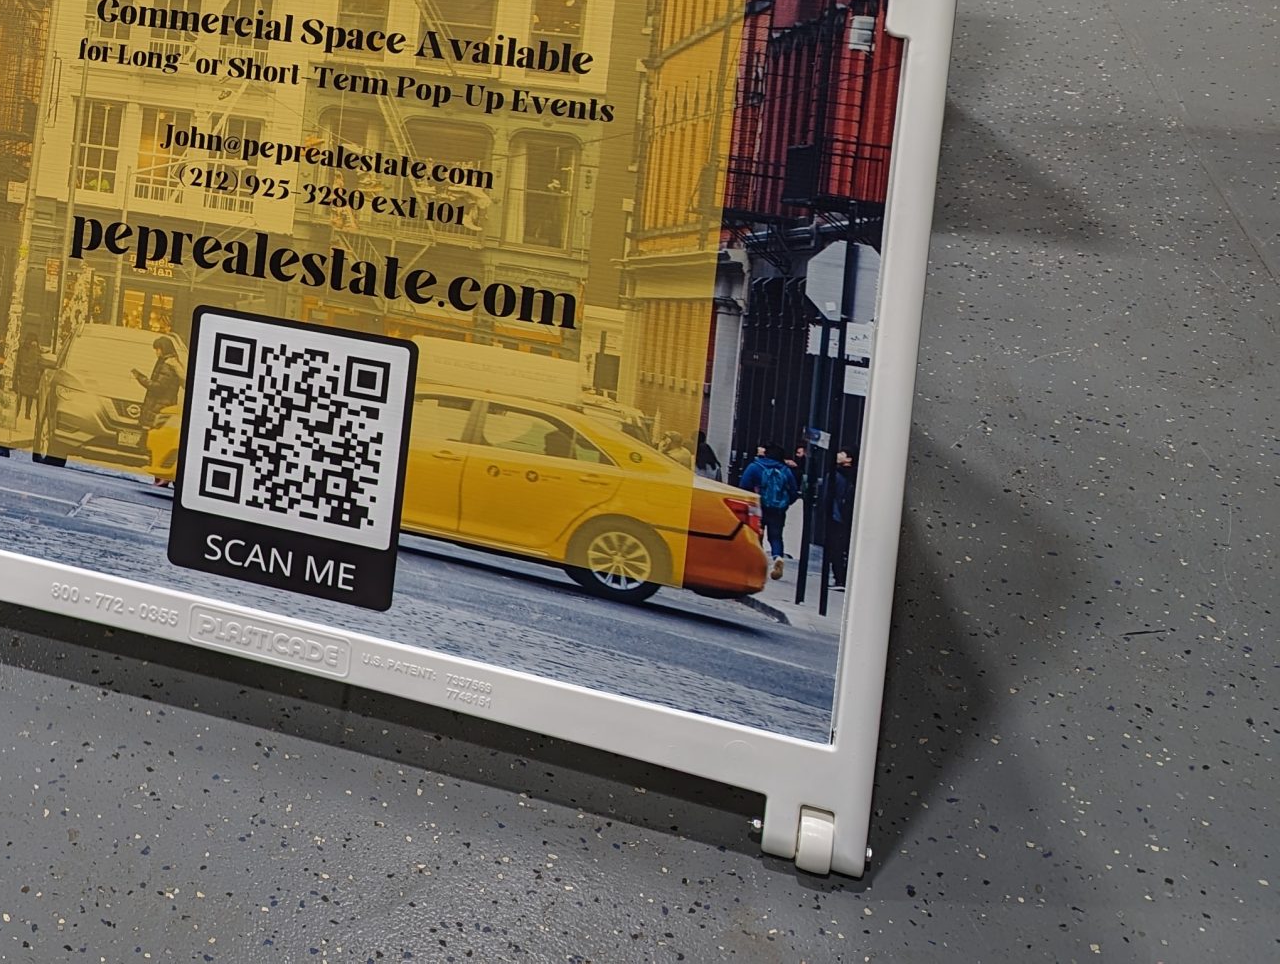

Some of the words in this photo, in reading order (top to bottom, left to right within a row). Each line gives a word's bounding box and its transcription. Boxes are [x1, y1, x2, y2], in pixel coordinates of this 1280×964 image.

[300, 18, 407, 53] Space
[414, 30, 594, 75] Available
[78, 37, 113, 62] for
[196, 57, 222, 76] or
[395, 75, 504, 114] Pop-Up
[511, 89, 615, 123] Events
[179, 164, 239, 194] (212)
[245, 174, 365, 211] 925-3280
[371, 195, 418, 220] ext
[426, 200, 465, 226] 101
[69, 214, 578, 330] peprealestate.com
[204, 533, 294, 578] SCAN
[304, 554, 357, 592] ME
[198, 613, 340, 667] PLASTICADE
[362, 652, 385, 668] U.S.
